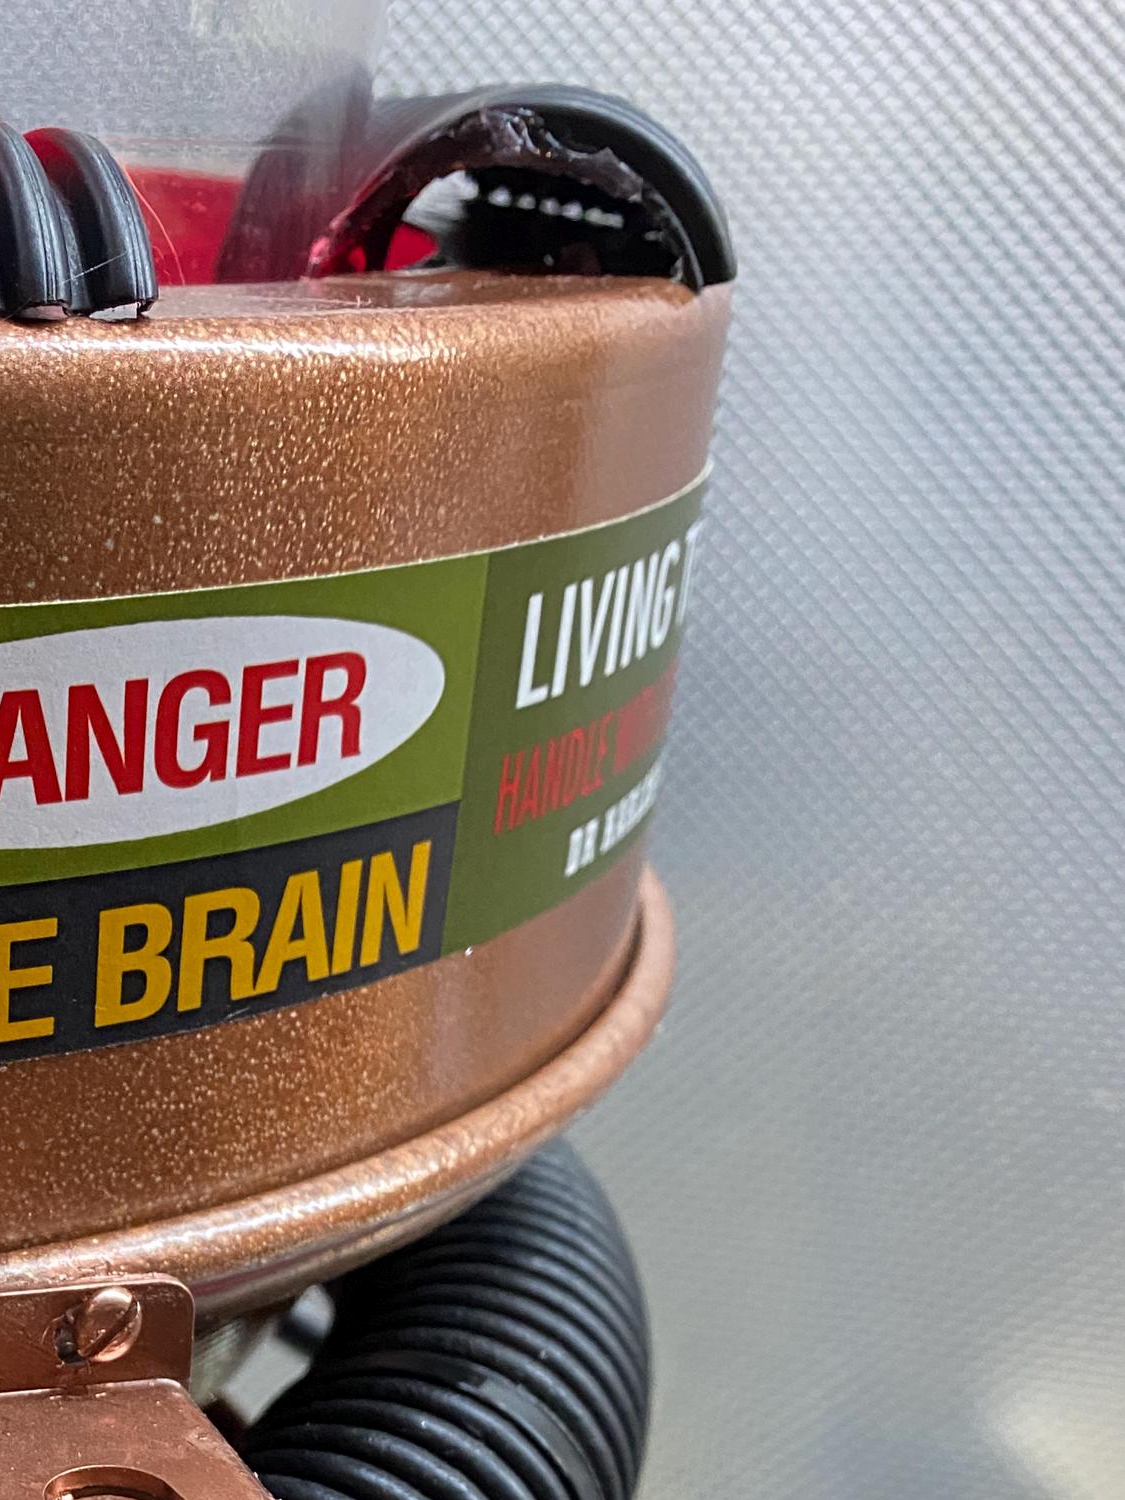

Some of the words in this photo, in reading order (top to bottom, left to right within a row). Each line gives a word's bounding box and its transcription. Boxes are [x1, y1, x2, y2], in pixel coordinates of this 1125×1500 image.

[515, 539, 681, 710] LIVING
[493, 710, 615, 836] HANDLE
[94, 839, 433, 1029] BRAIN
